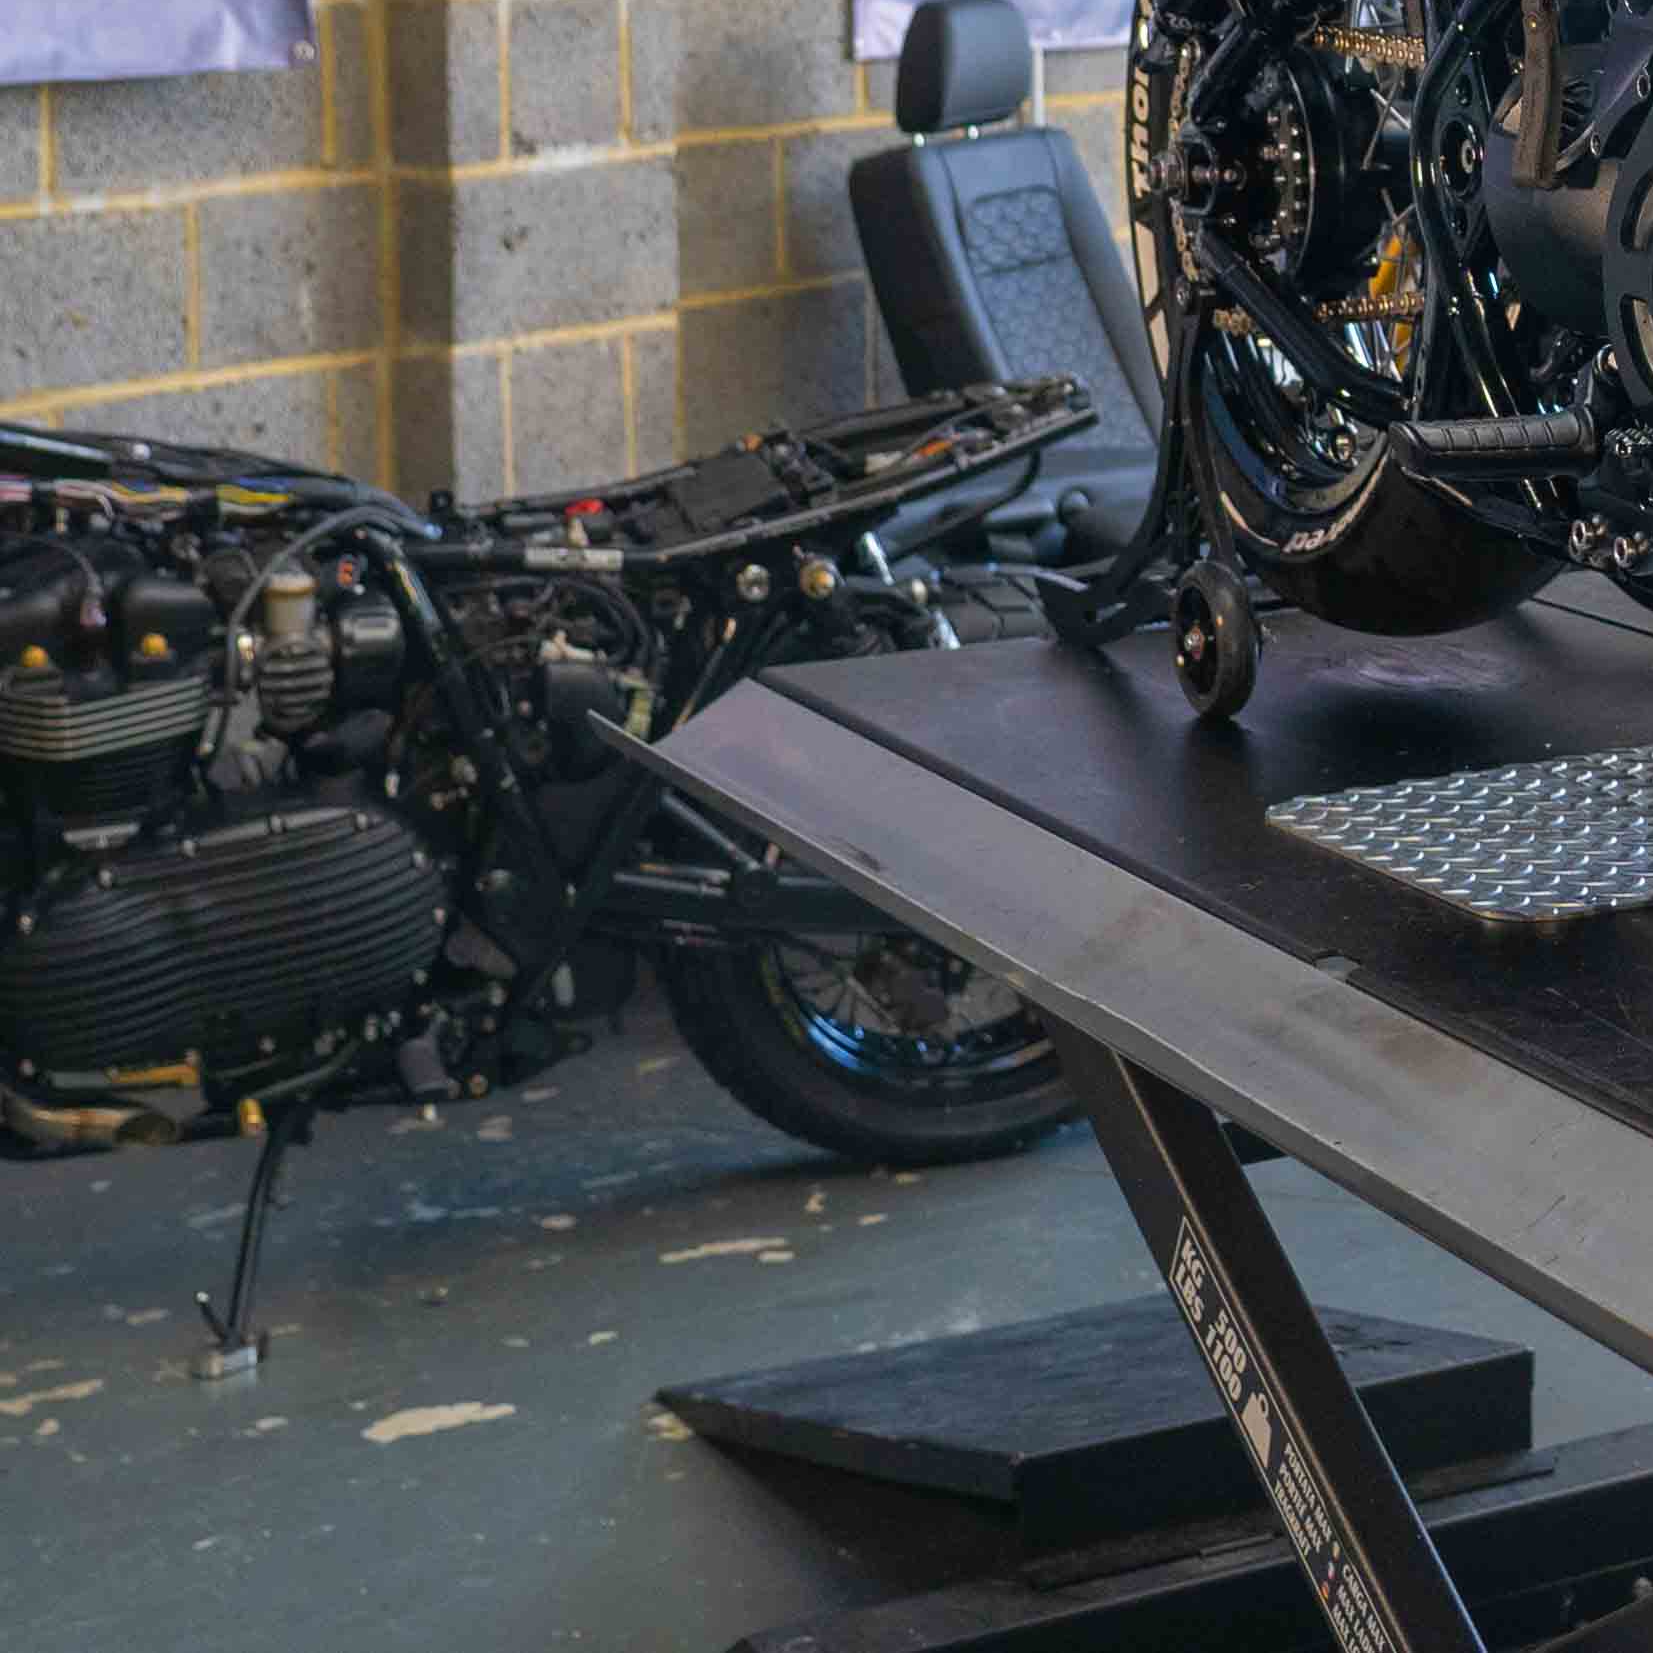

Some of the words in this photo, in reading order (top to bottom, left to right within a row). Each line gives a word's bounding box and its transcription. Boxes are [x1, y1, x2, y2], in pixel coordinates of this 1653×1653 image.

[1175, 1263, 1205, 1322] LBS
[1206, 1324, 1242, 1401] 1100
[1182, 1239, 1205, 1289] KG
[1215, 1310, 1246, 1375] 500
